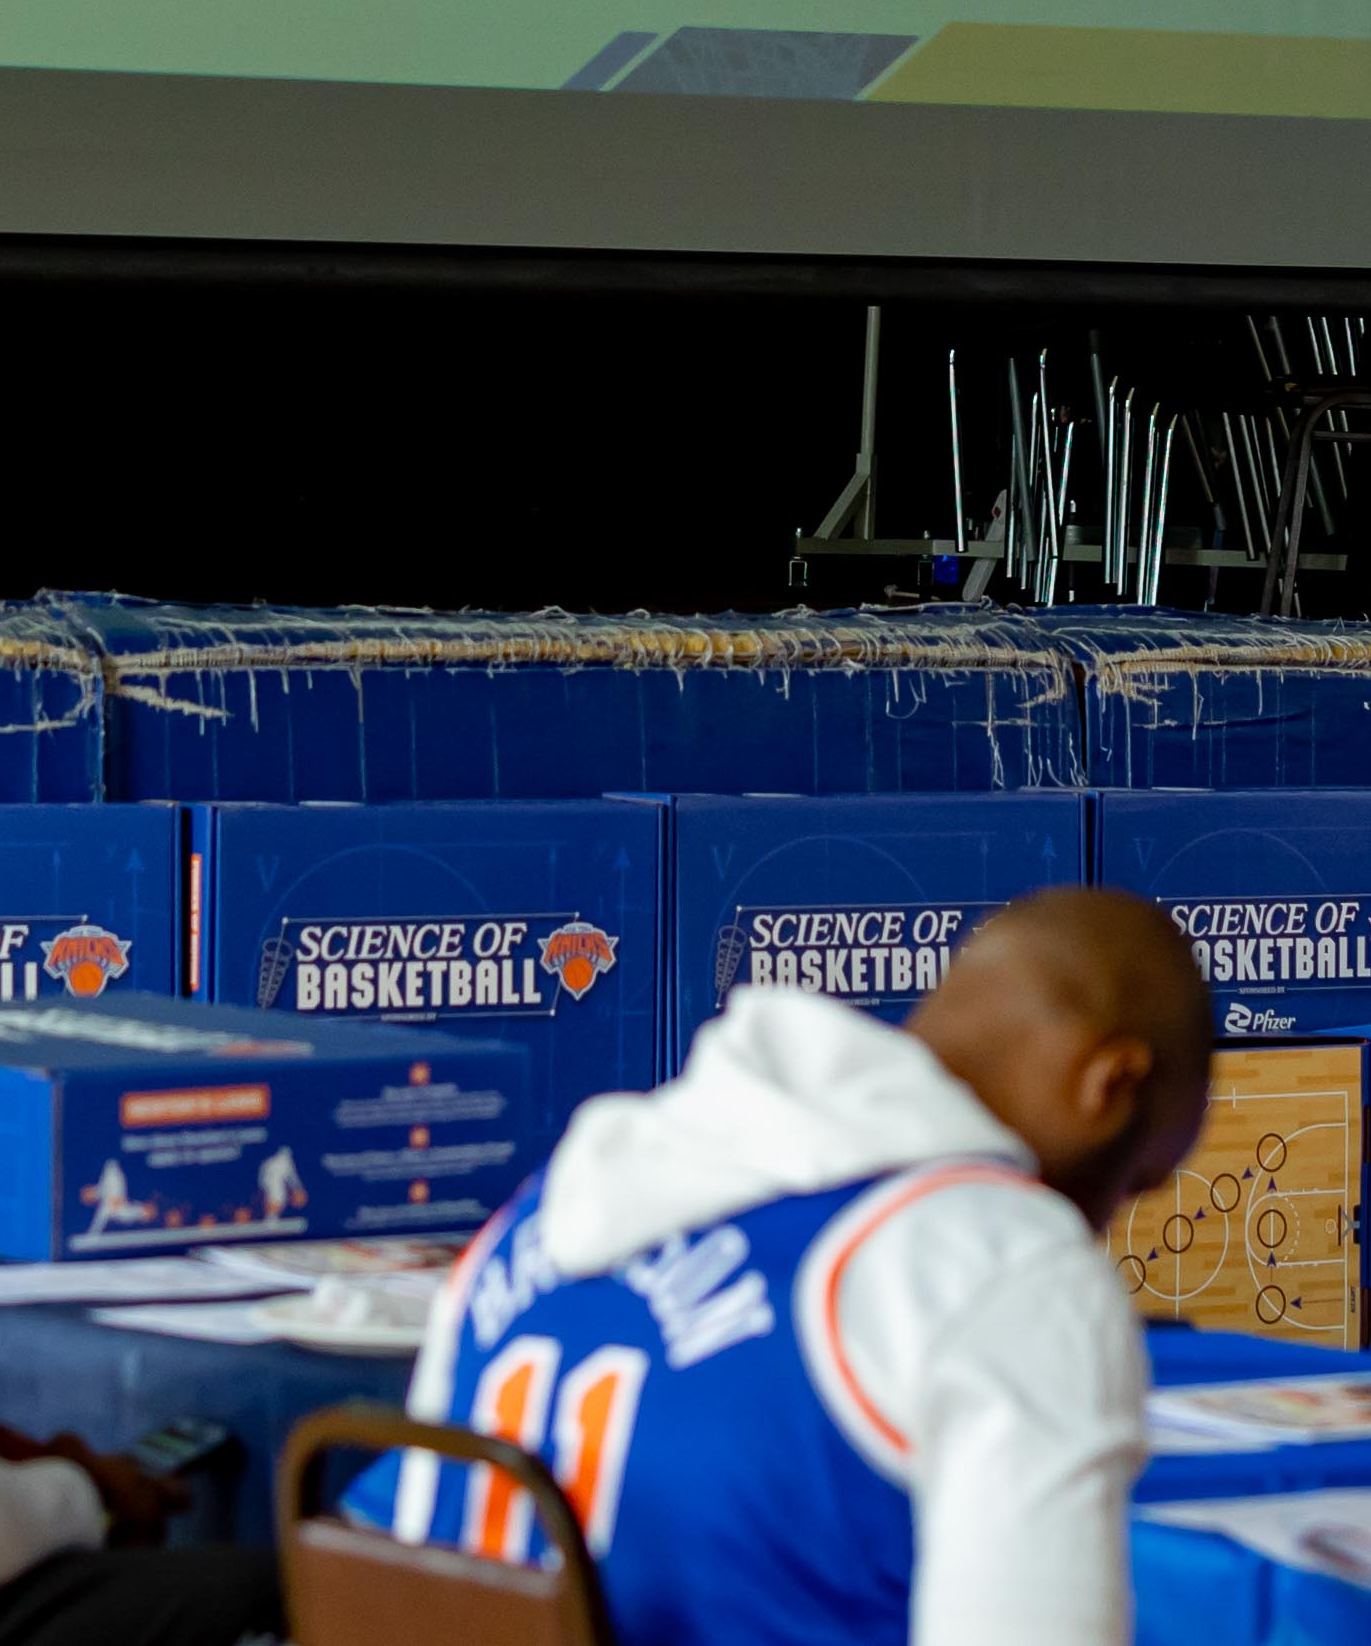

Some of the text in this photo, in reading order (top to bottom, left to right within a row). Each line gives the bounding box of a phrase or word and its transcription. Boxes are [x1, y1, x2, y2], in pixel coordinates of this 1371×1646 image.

[749, 910, 963, 948] SCIENCE OF
[1171, 902, 1360, 936] SCIENCE OF
[295, 922, 527, 962] SCIENCE OF
[1192, 935, 1371, 981] ASKETBALL
[296, 958, 542, 1011] BASKETBALL
[750, 945, 952, 993] BASKETBAL
[1252, 1008, 1297, 1033] Pfizer
